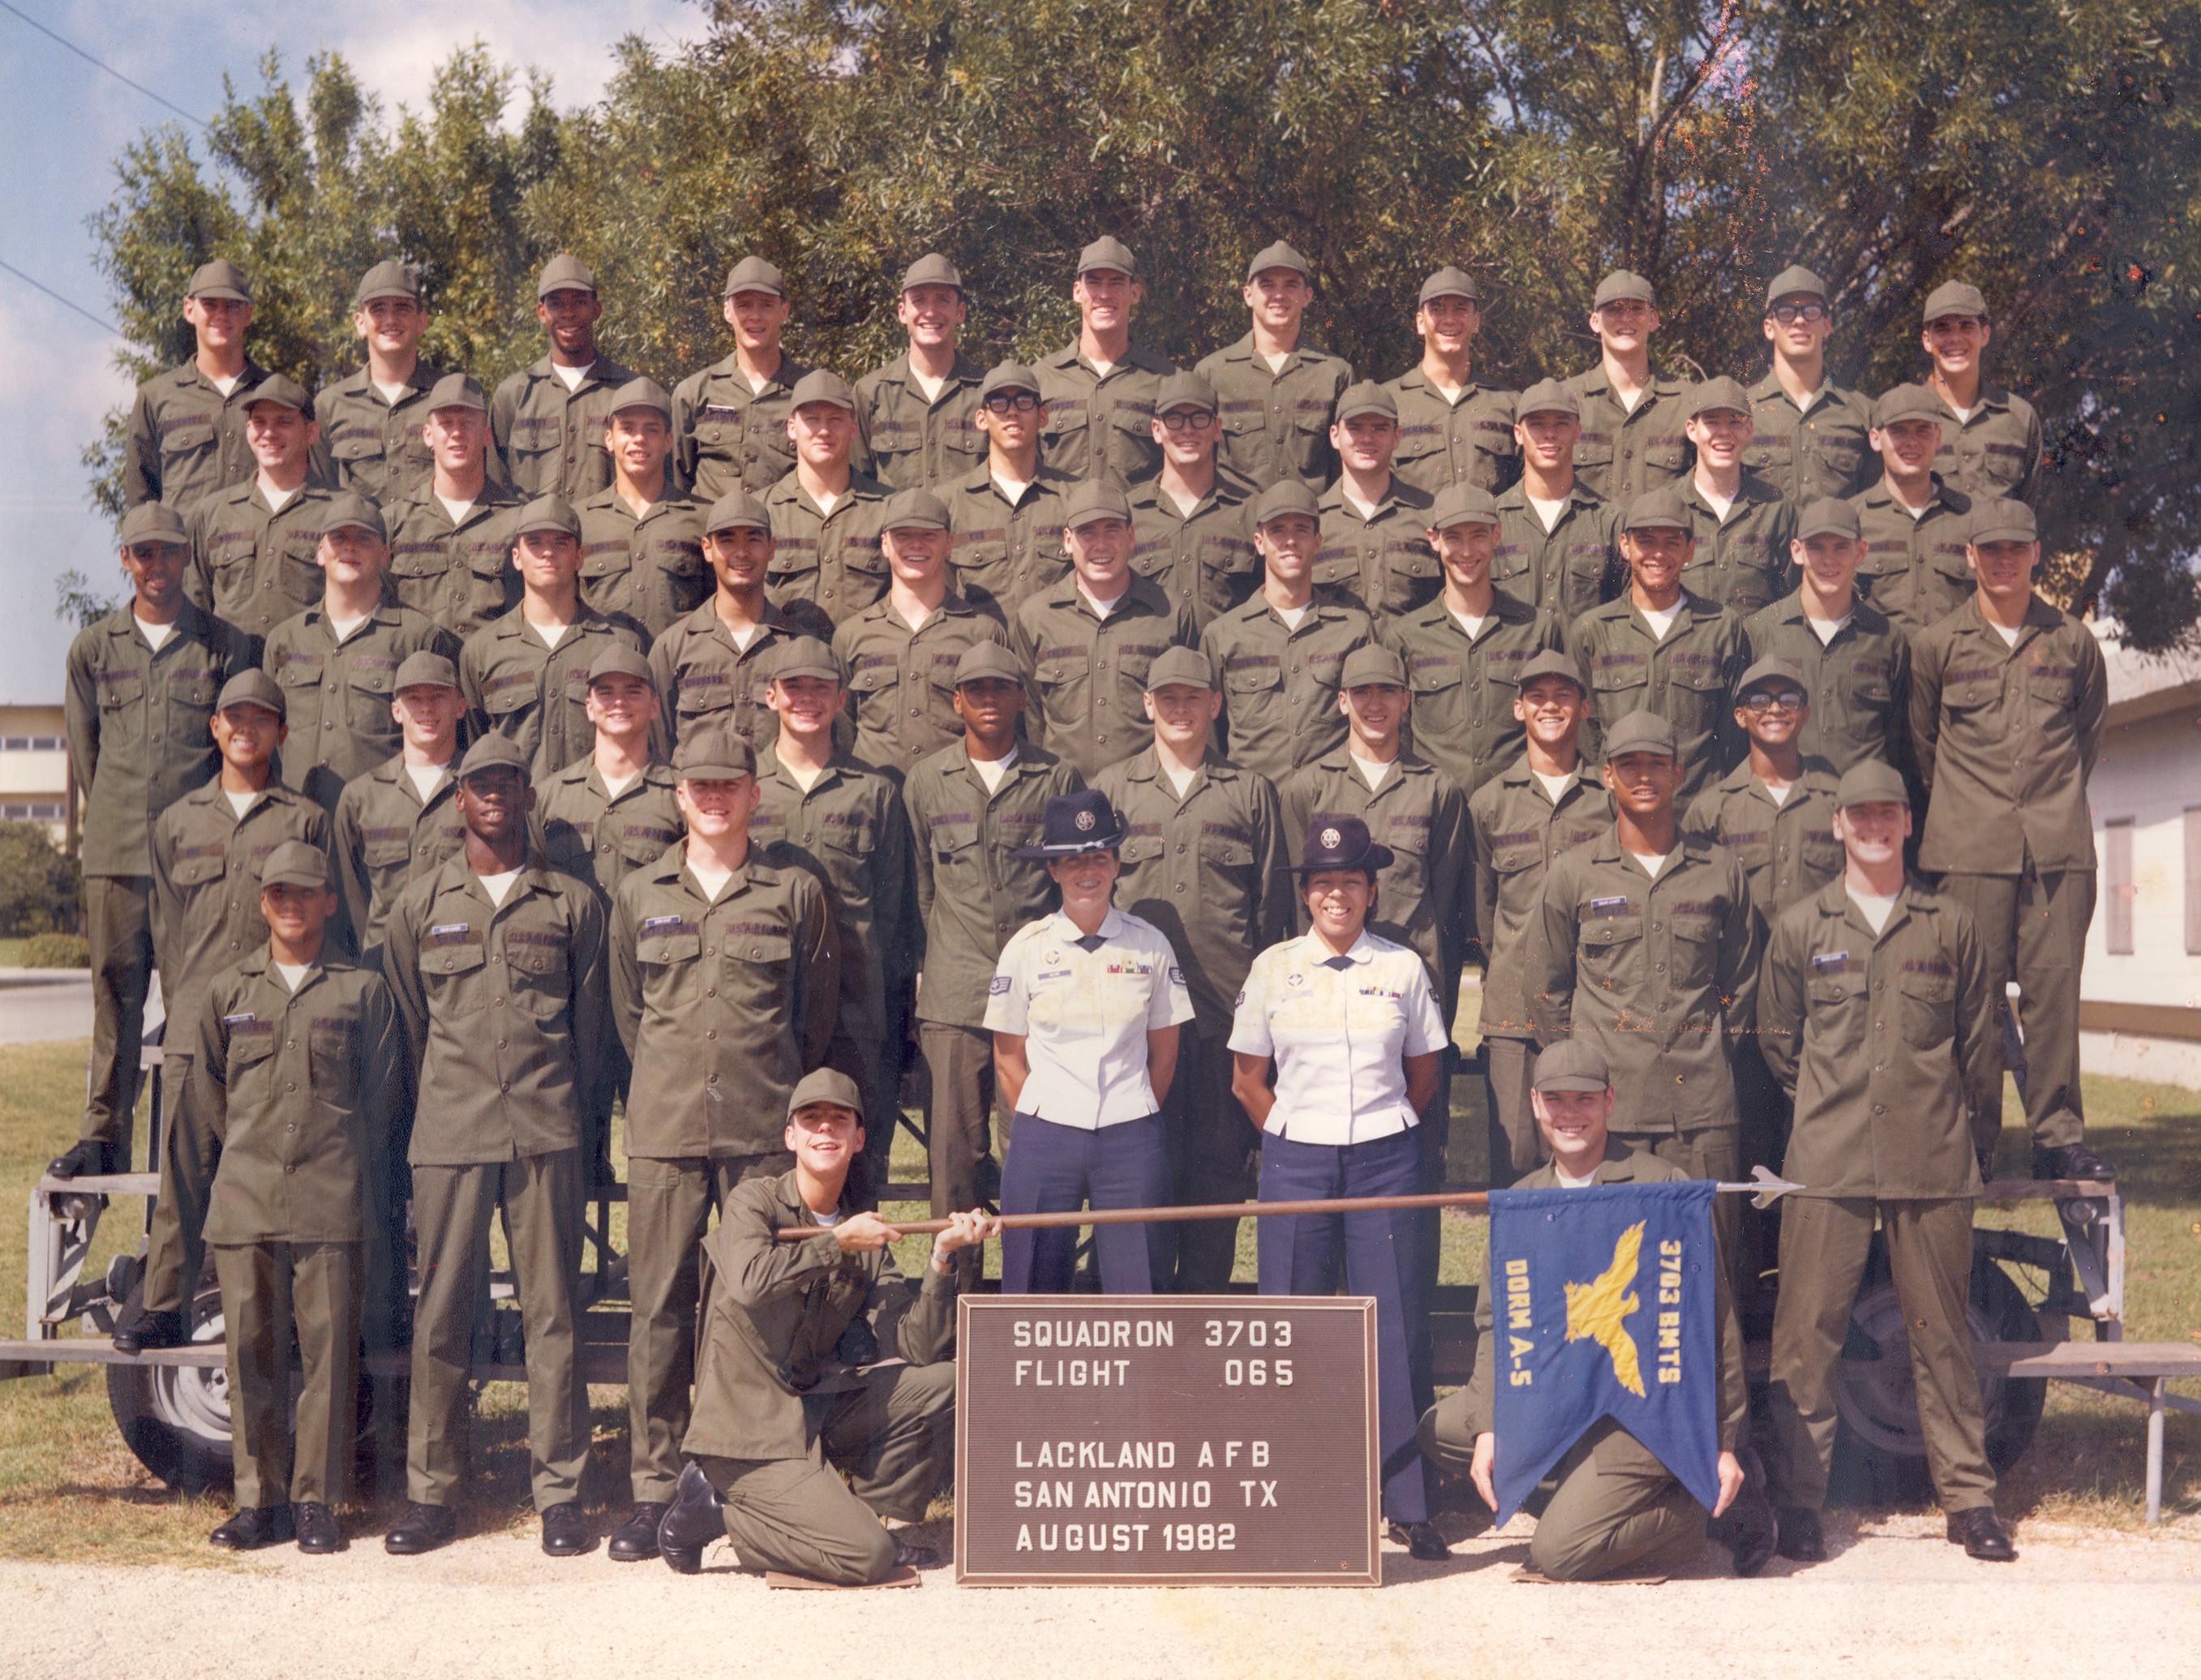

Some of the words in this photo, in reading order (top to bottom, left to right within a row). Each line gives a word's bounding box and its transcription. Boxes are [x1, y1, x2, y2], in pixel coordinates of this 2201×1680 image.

[1658, 1240, 1682, 1305] 3703
[1505, 1259, 1532, 1329] DORM
[1015, 1321, 1173, 1347] SQUADRON
[1205, 1321, 1292, 1347] 3703
[1658, 1312, 1681, 1383] BMTS
[1015, 1361, 1130, 1386] FLIGHT
[1225, 1360, 1293, 1386] 065
[1509, 1336, 1534, 1386] A-5
[1016, 1442, 1175, 1468] LACKLAND
[1015, 1481, 1073, 1508] SAN
[1084, 1481, 1211, 1508] ANTONIO
[1240, 1481, 1277, 1507] TX
[1016, 1524, 1149, 1551] AUGUST
[1163, 1524, 1236, 1551] 1982
